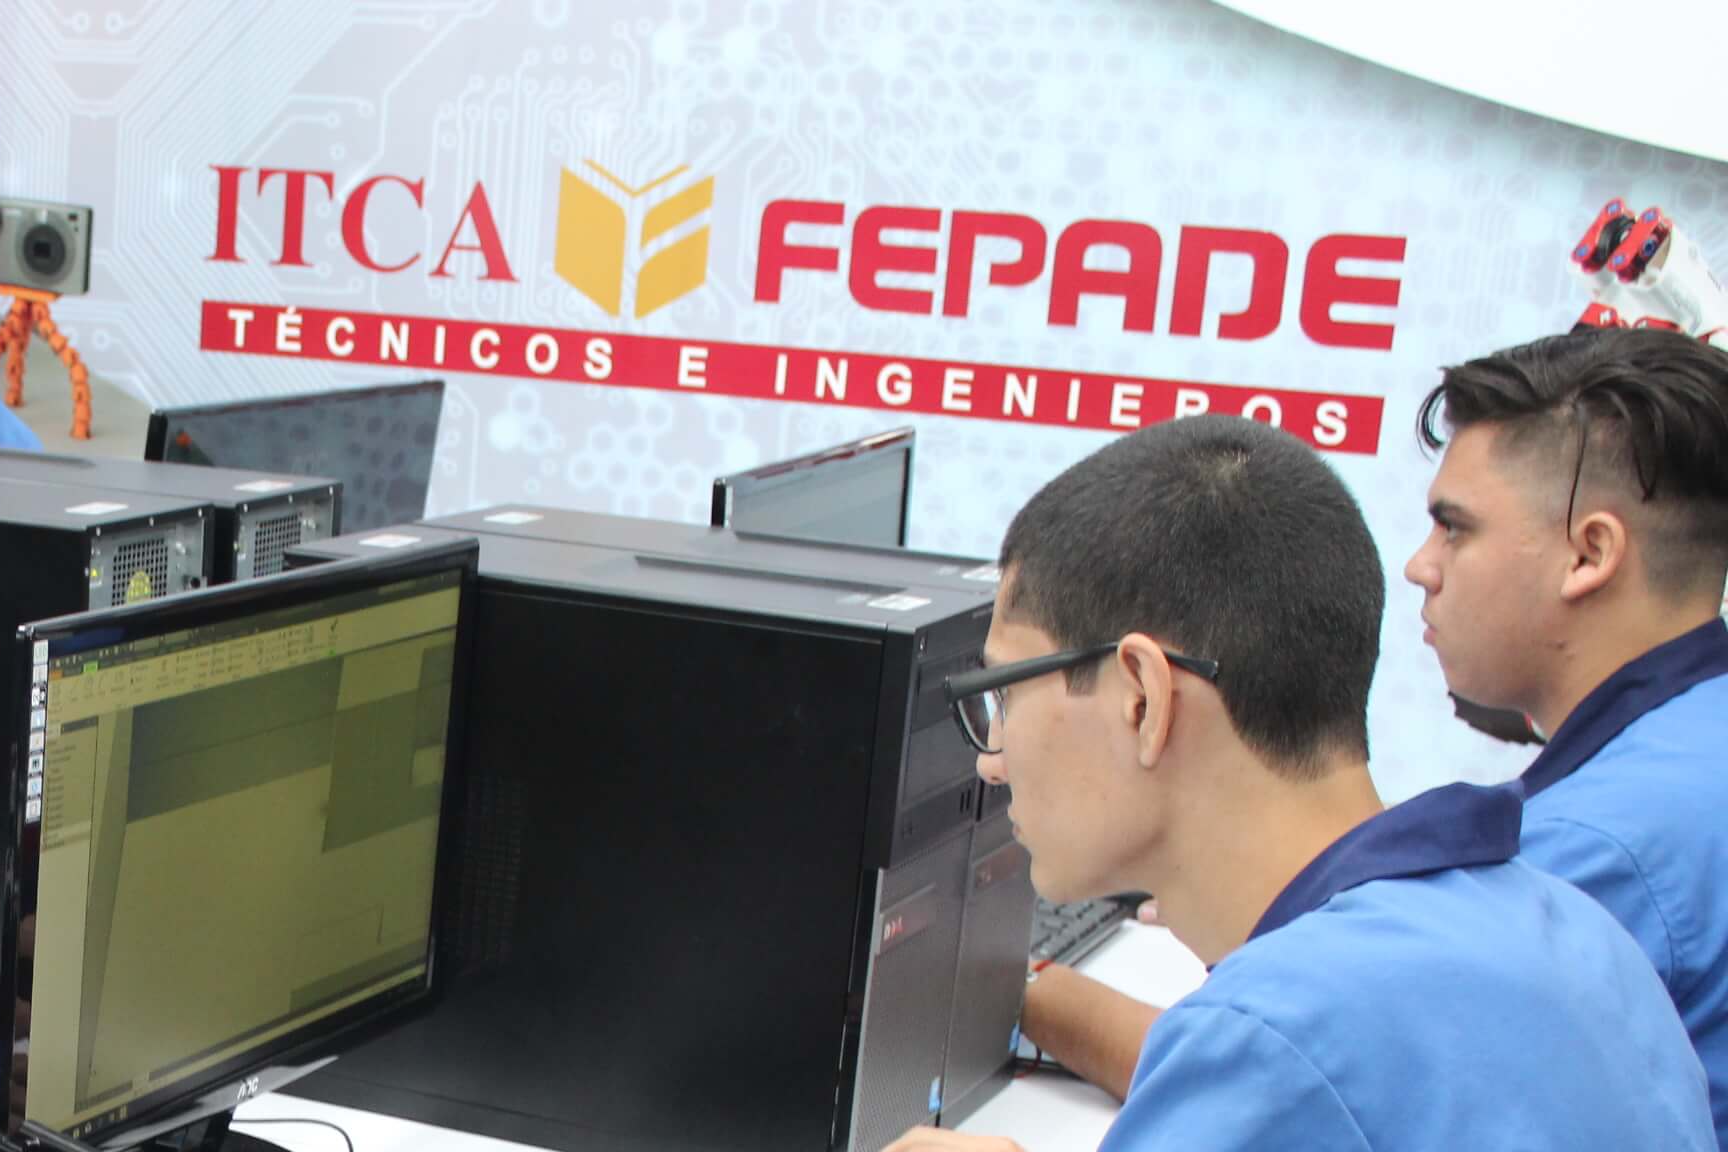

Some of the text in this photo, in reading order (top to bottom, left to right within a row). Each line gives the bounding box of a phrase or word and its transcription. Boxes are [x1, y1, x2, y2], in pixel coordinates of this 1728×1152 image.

[204, 163, 1407, 352] ITCA FEPADE
[226, 306, 614, 380] TÉCNICOS
[677, 346, 710, 387] E
